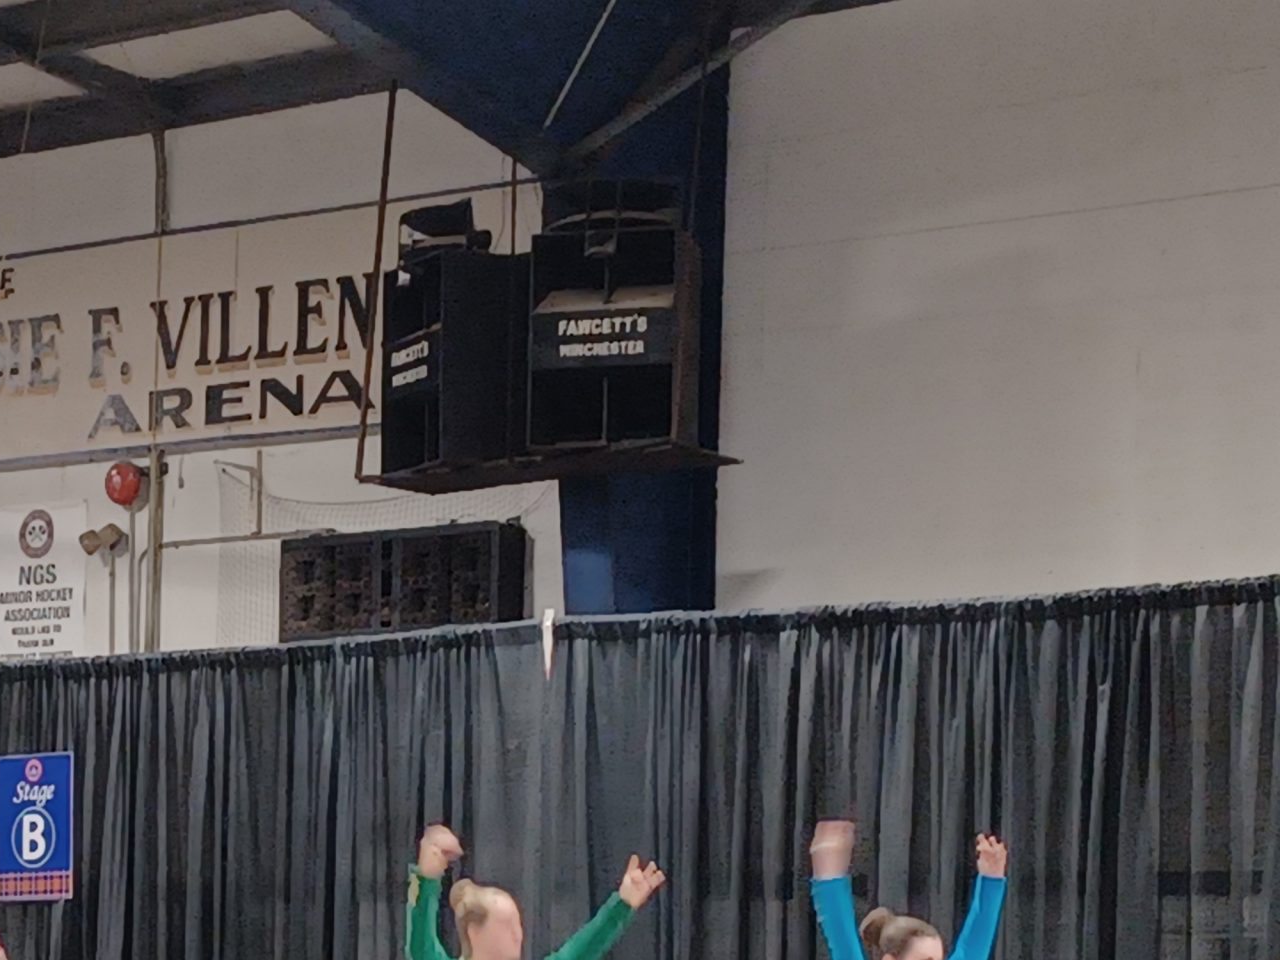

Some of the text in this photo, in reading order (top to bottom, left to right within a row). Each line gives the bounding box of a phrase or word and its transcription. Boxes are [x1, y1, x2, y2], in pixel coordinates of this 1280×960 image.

[87, 306, 129, 381] F.
[87, 369, 376, 440] ARENA
[19, 564, 57, 585] NGS
[35, 587, 73, 602] HOCKEY
[4, 606, 70, 622] ASSOCIATION
[12, 781, 55, 808] Stage
[22, 813, 46, 861] B
